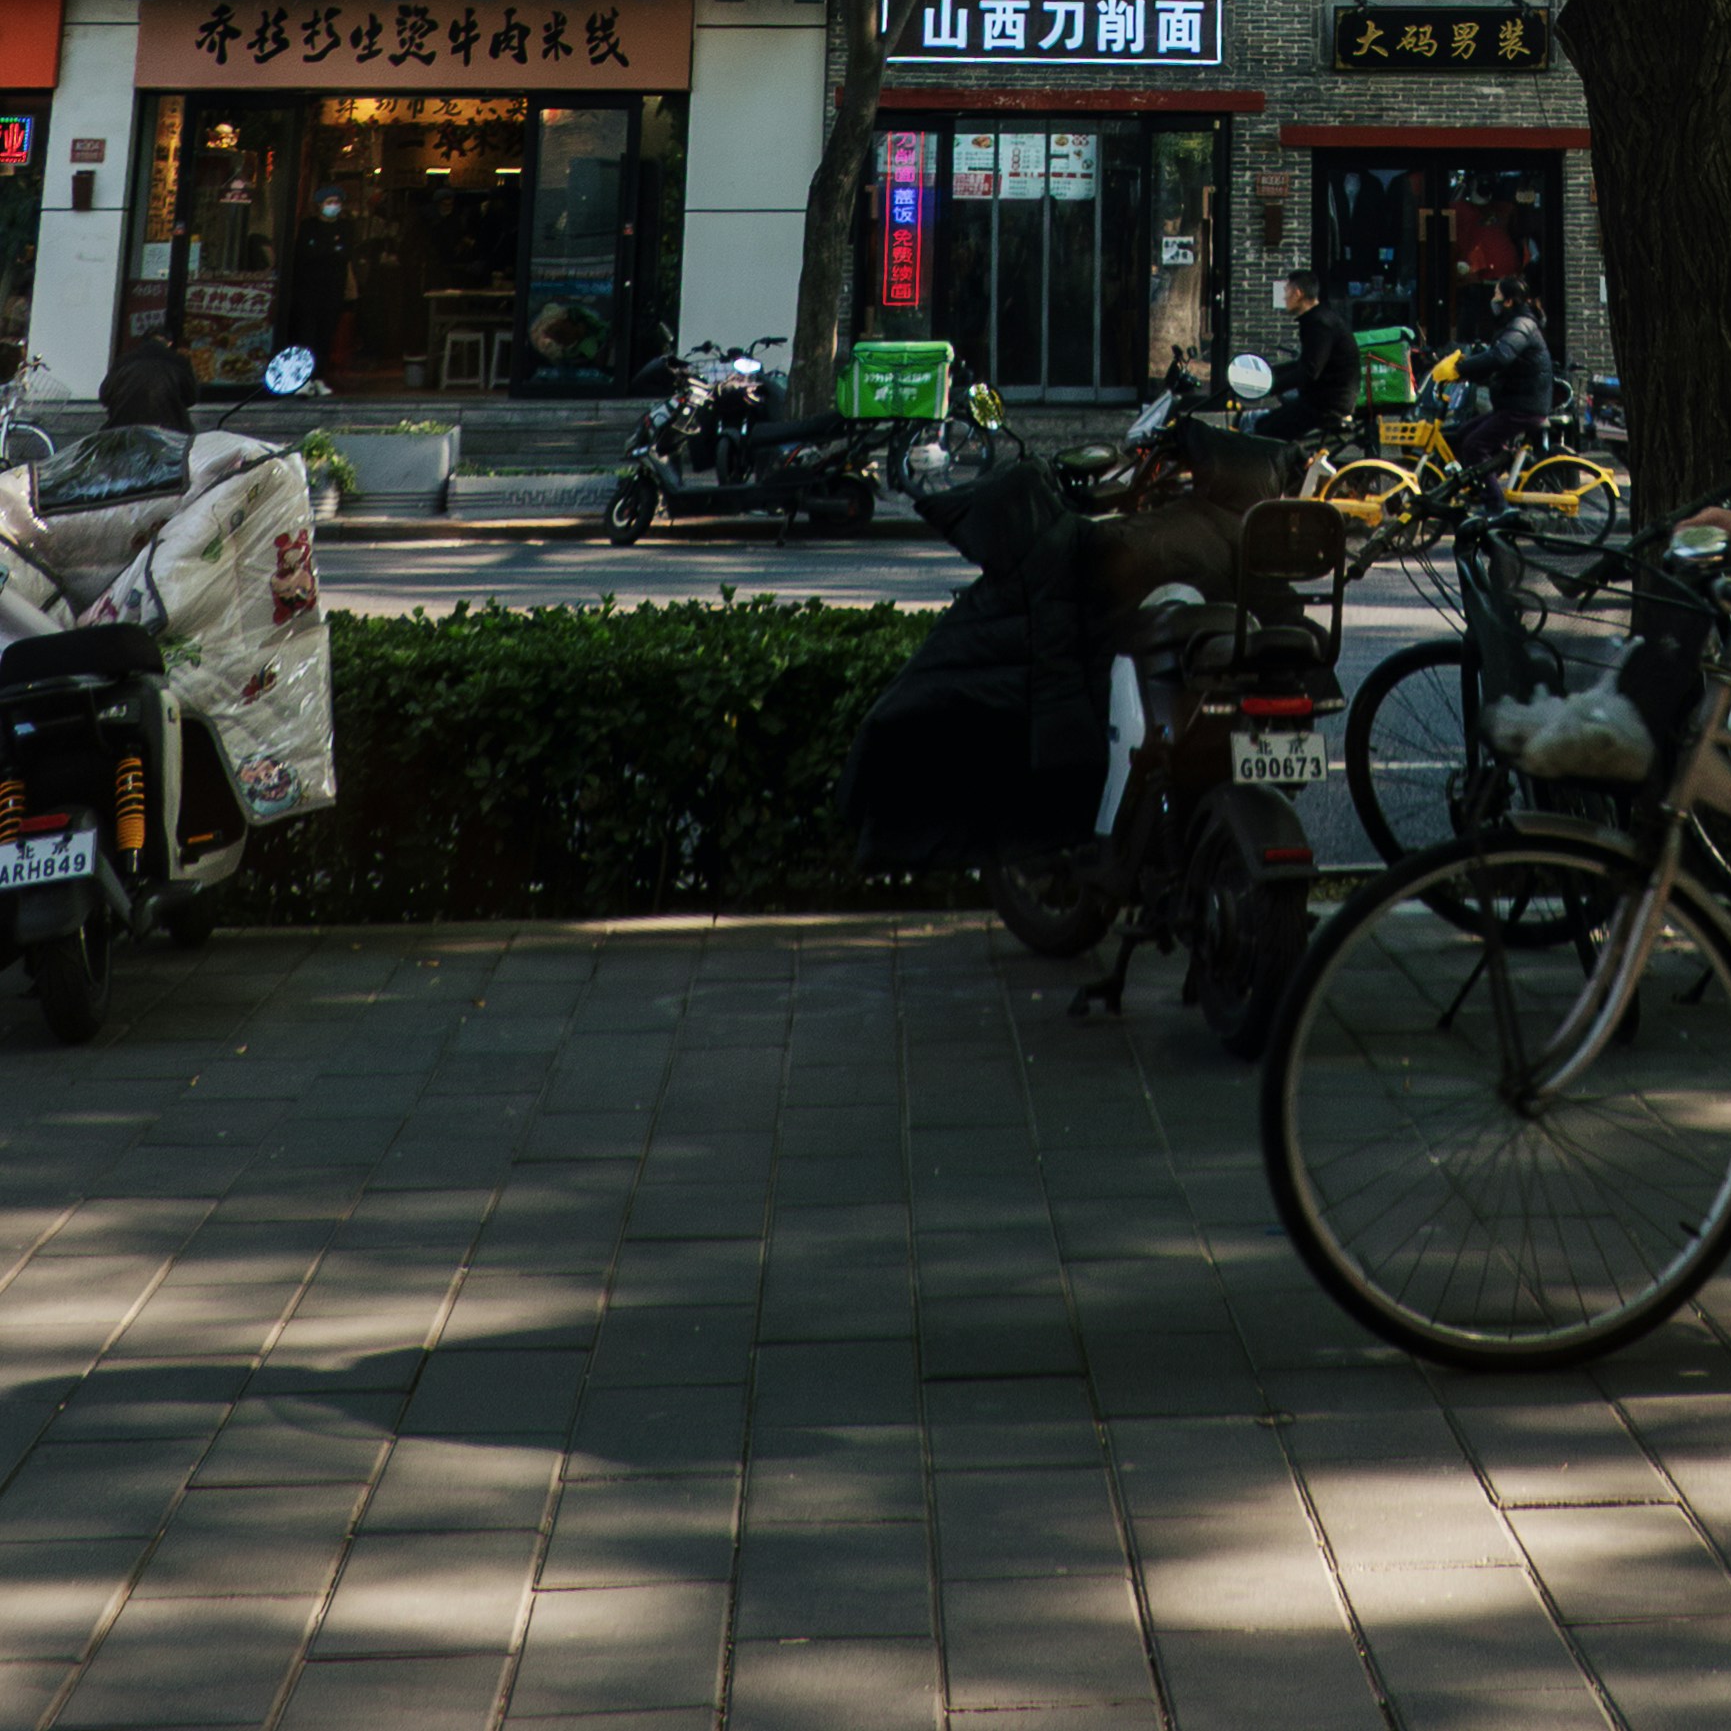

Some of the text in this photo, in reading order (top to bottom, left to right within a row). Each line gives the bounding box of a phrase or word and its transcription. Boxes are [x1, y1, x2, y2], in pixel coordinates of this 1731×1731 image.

[1352, 18, 1531, 61] 大码男装
[892, 188, 917, 224] 盖饭
